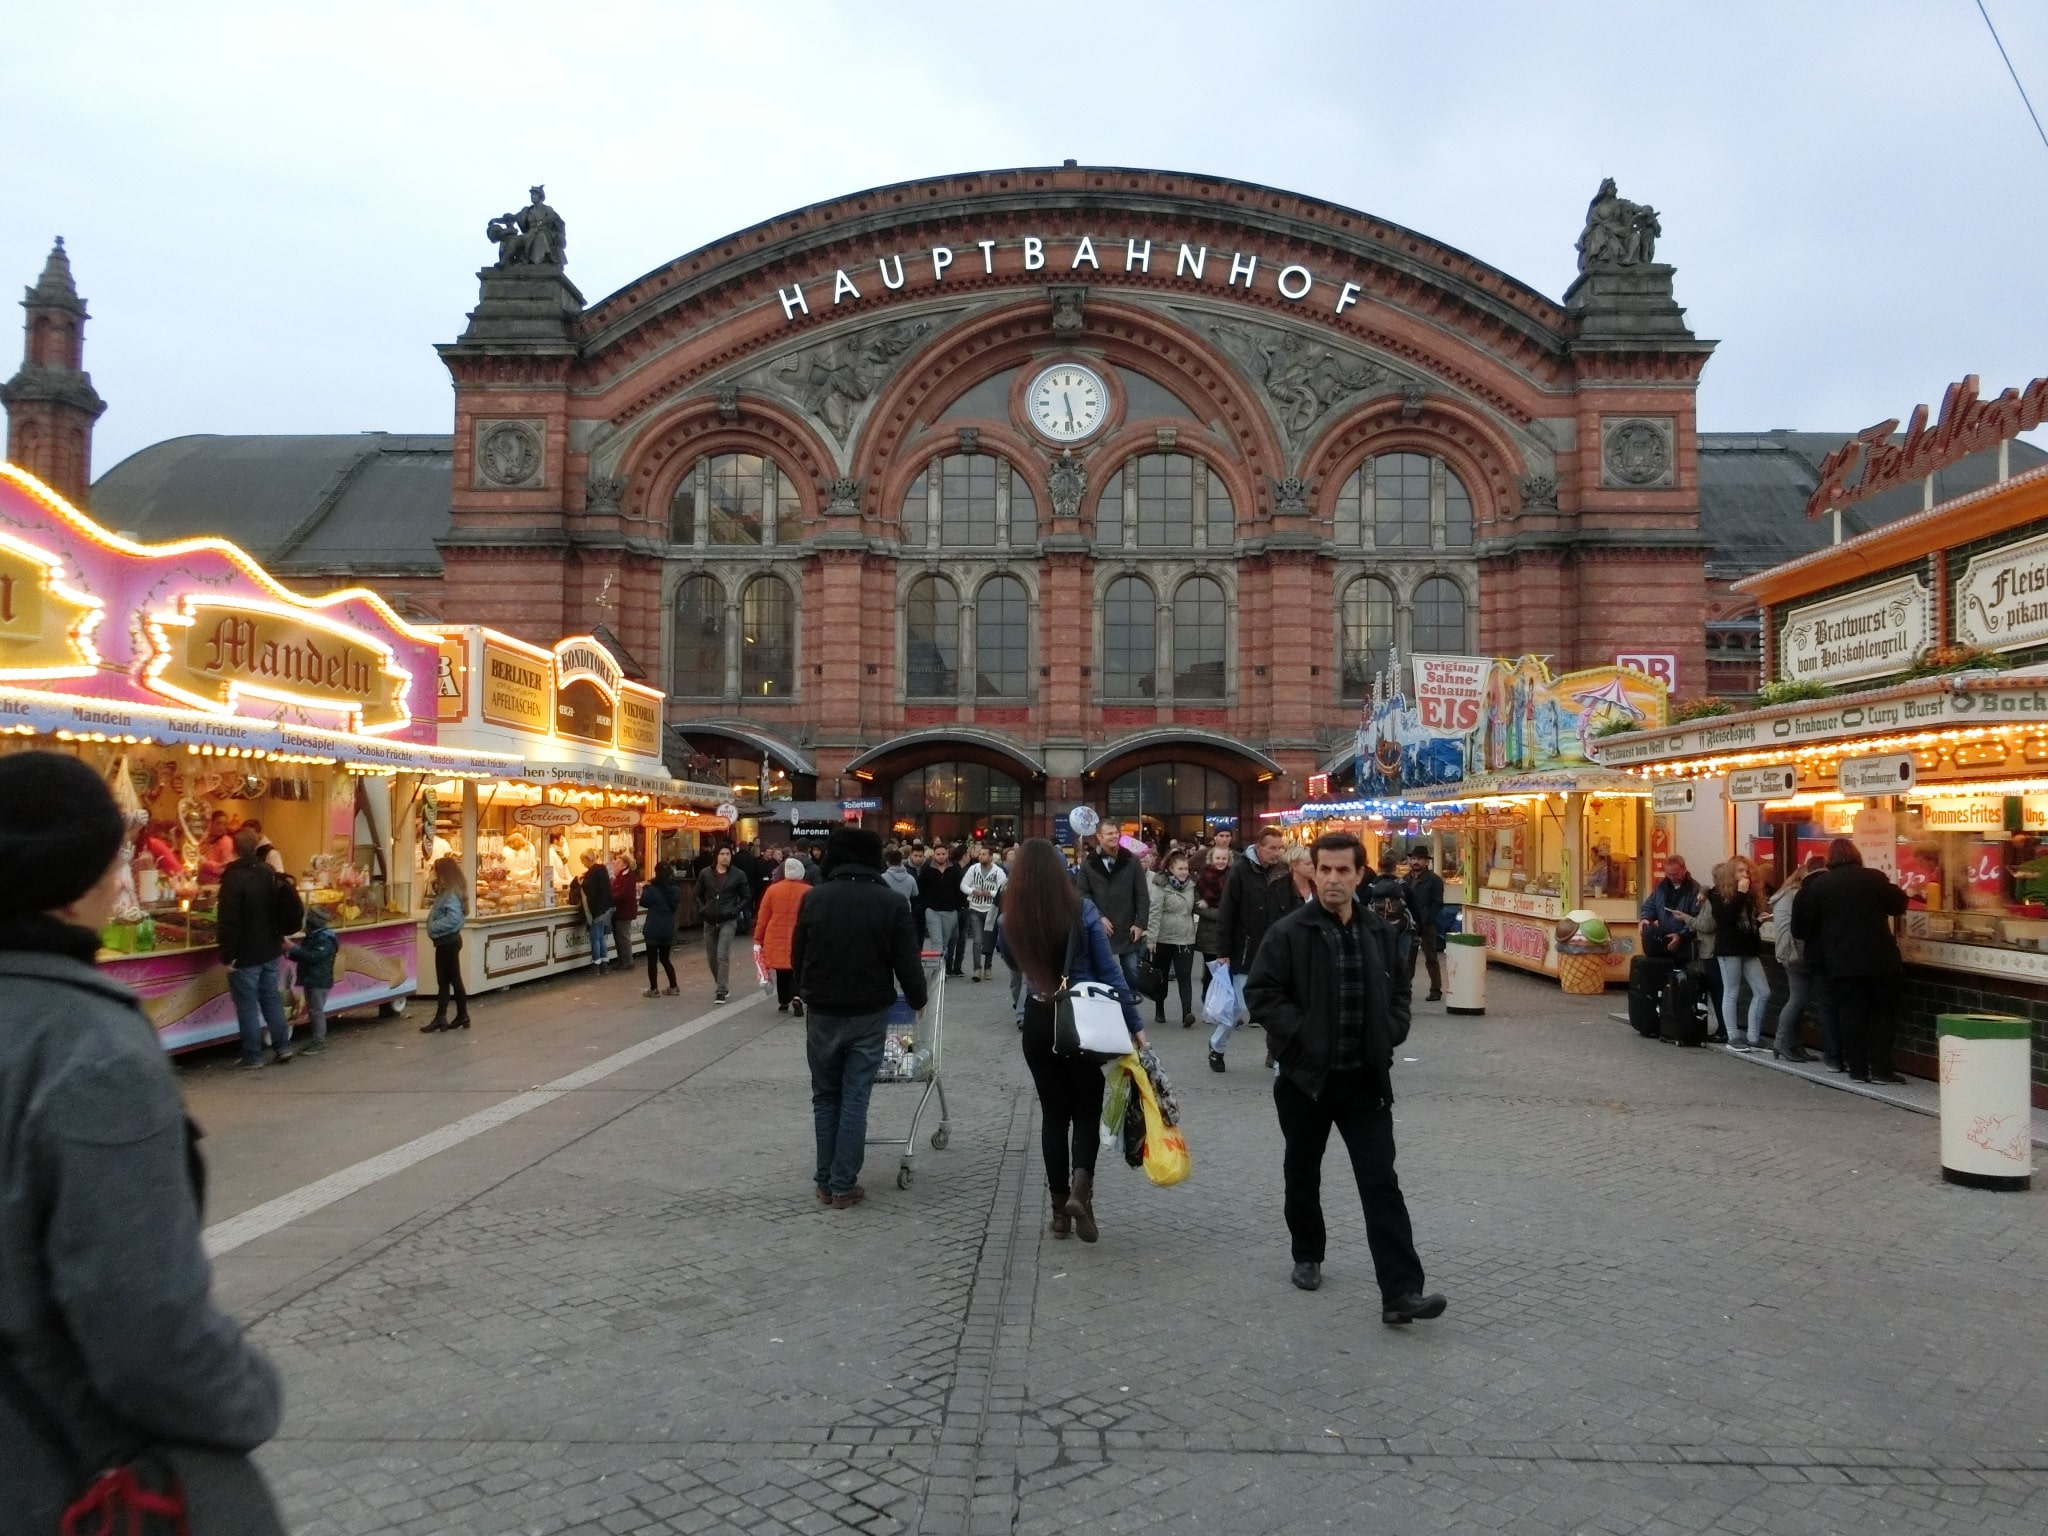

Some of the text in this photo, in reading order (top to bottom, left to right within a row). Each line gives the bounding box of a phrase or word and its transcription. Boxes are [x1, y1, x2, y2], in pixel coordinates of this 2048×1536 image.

[778, 236, 1361, 320] HAUPTBAHNHOF
[1989, 562, 2048, 608] Fleis
[1814, 606, 1887, 650] Bratwurst
[205, 616, 372, 694] Mandeln
[1424, 661, 1480, 674] Original
[1798, 630, 1908, 673] vom Holzkohlengrill
[491, 659, 542, 691] BERLINER
[562, 649, 614, 690] KONDITOREI
[1426, 672, 1478, 685] Sahne-
[491, 692, 541, 717] APFELTASCHEN
[1420, 683, 1482, 697] Schaum-
[1418, 697, 1481, 730] EIS
[1795, 716, 1838, 735] Krakauer
[1868, 707, 1898, 724] Curry
[1904, 696, 1944, 720] Wurst
[1980, 691, 2048, 713] Bock
[72, 706, 131, 726] Mandeln
[168, 719, 202, 734] Kand.
[205, 722, 248, 739] Früchte
[281, 733, 335, 751] Liebesäpfel
[357, 745, 385, 758] Schoko
[386, 748, 413, 762] Früchte
[520, 809, 572, 822] Berliner
[590, 812, 632, 823] Victoria
[1925, 804, 1968, 825] Pommes
[1970, 803, 2002, 824] Frites
[792, 827, 830, 836] Maronen
[505, 941, 533, 961] Berliner
